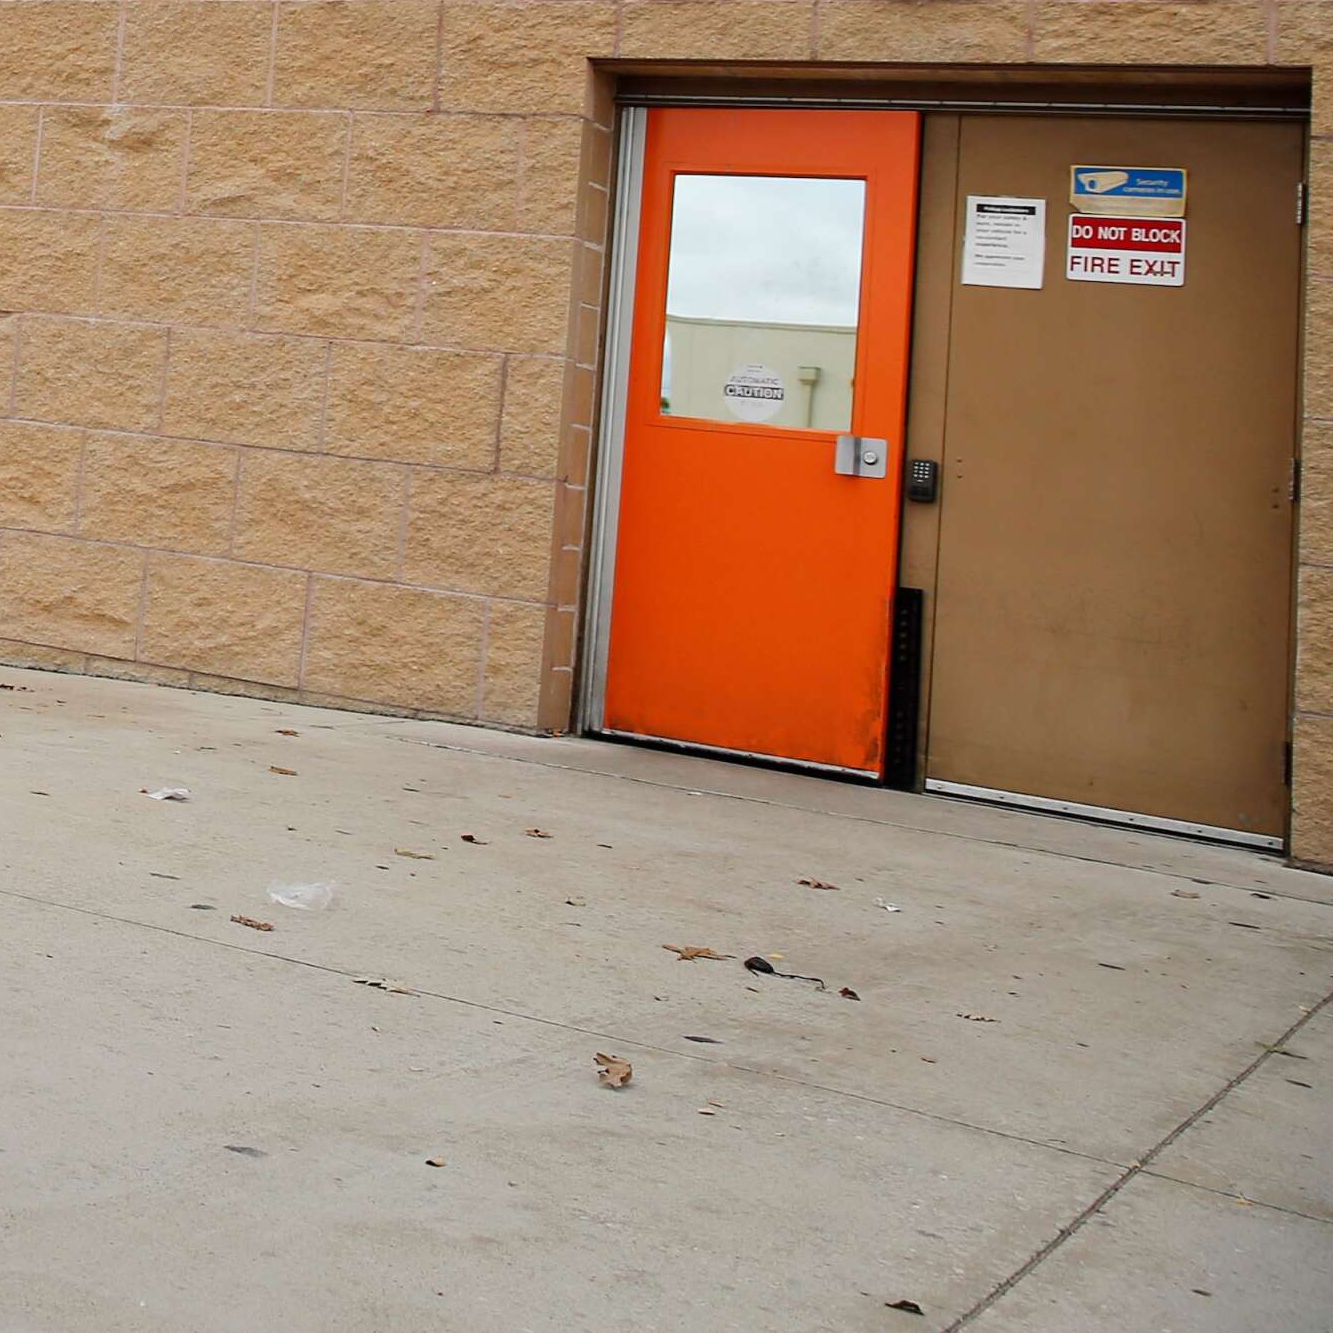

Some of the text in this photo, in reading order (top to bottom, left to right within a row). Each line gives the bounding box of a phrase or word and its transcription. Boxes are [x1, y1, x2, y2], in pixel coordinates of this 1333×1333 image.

[1072, 224, 1181, 244] DO NOT BLOCK
[1069, 255, 1182, 278] FIRE EXIT
[725, 385, 783, 399] CAUTION
